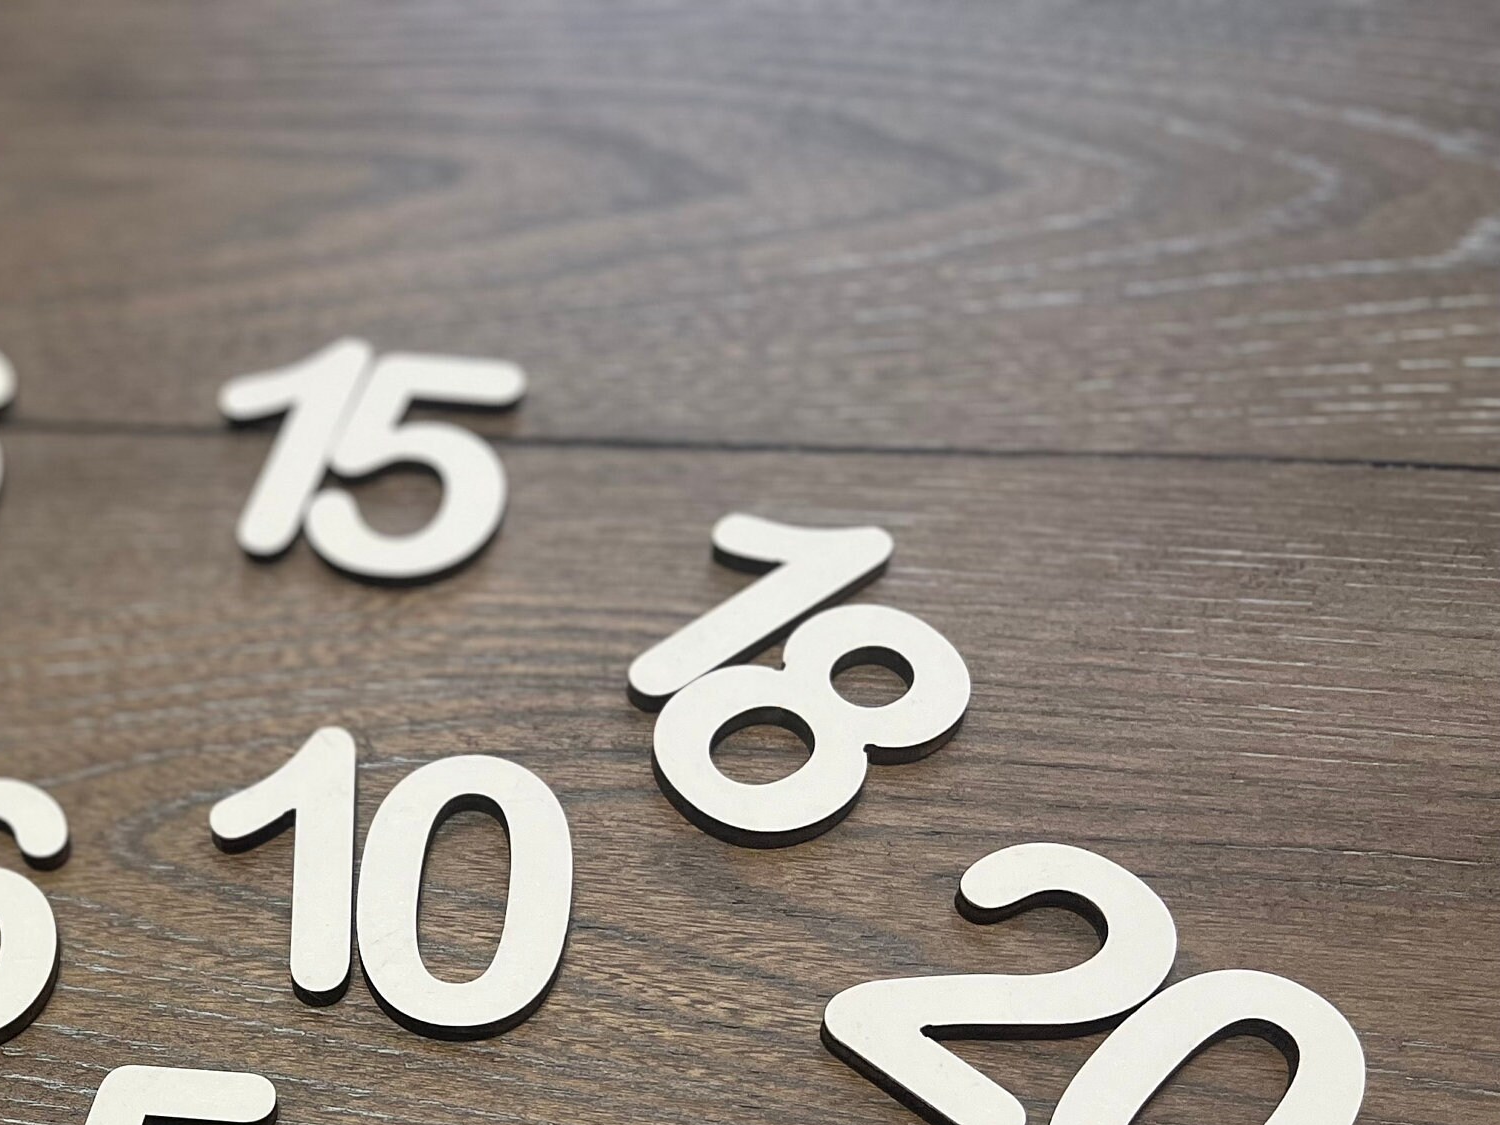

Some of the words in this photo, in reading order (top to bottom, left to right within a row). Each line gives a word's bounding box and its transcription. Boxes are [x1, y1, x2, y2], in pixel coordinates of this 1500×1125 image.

[219, 336, 526, 581] 15
[628, 511, 973, 841] 18
[208, 724, 574, 1030] 10
